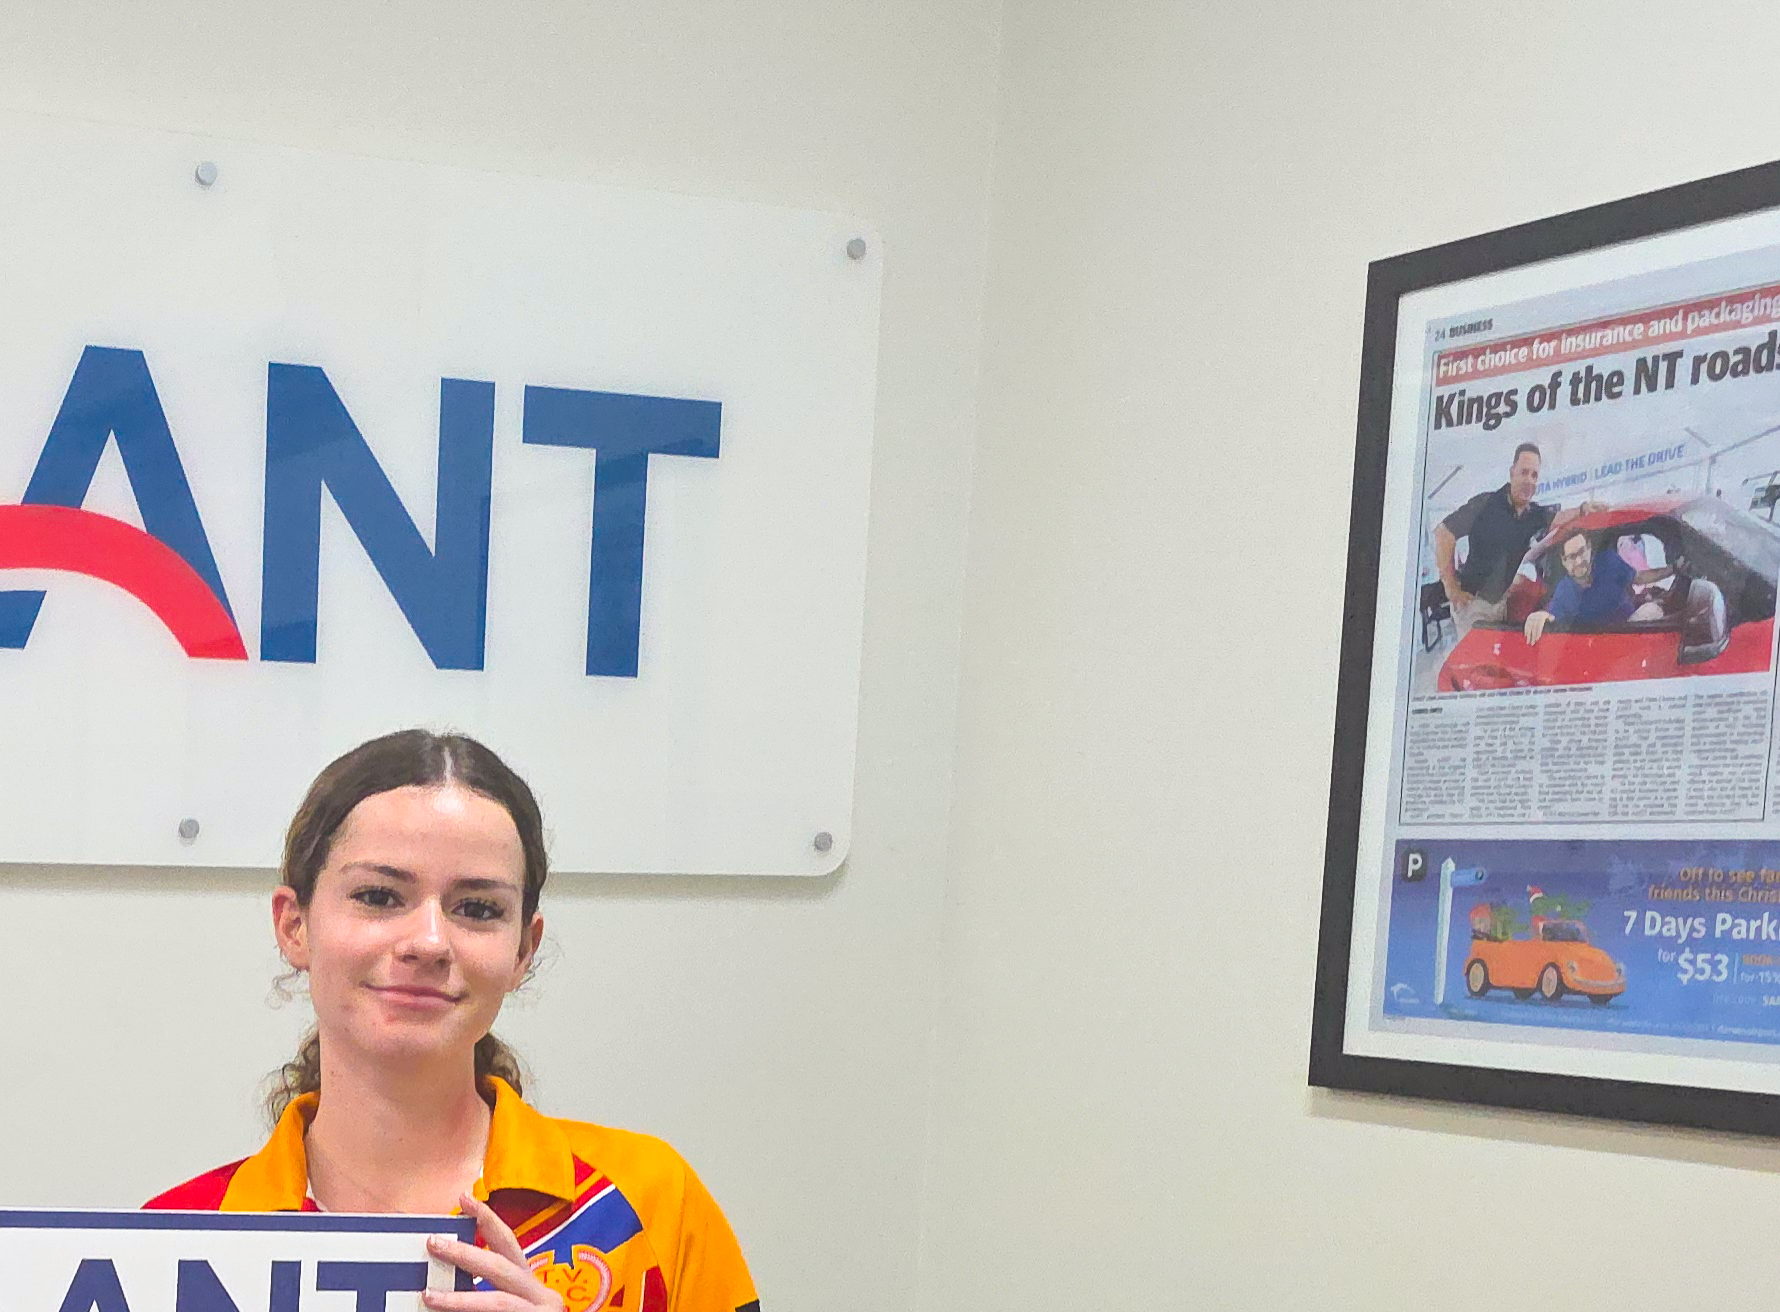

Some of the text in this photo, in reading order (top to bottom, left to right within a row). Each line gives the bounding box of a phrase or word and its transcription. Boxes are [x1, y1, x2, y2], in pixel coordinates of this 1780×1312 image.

[1439, 354, 1474, 379] First
[1477, 345, 1528, 371] choice
[1532, 338, 1558, 360] for
[1561, 322, 1644, 355] insurance
[1648, 309, 1684, 337] and
[1434, 329, 1780, 431] Kings of the NT road
[1625, 454, 1646, 472] THE
[1407, 853, 1423, 878] P
[1679, 866, 1704, 883] Off
[1708, 867, 1724, 883] to
[1728, 870, 1756, 883] see
[1648, 882, 1700, 901] friends
[1704, 885, 1734, 903] this
[1623, 909, 1638, 935] 7
[1644, 910, 1707, 944] Days
[1657, 948, 1677, 963] for
[1676, 947, 1729, 986] $53
